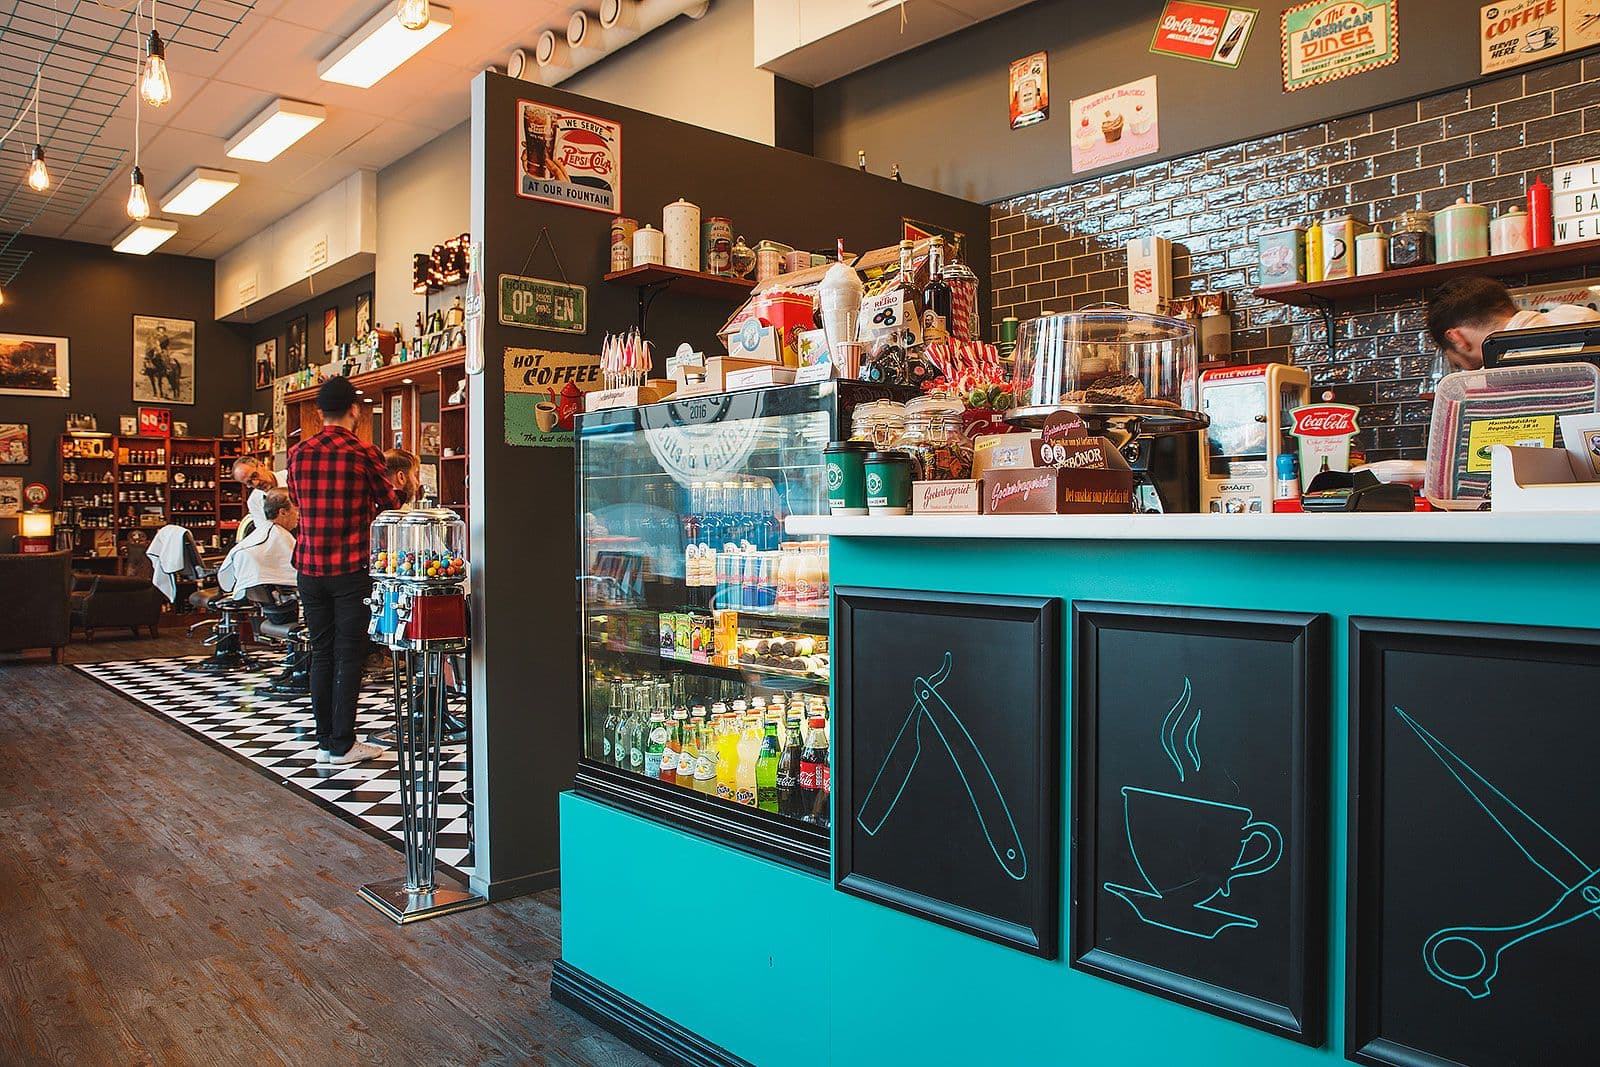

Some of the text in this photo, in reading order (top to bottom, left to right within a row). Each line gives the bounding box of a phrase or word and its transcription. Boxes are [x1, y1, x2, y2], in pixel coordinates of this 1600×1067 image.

[1324, 5, 1346, 24] The
[1486, 0, 1558, 40] COFFEE
[1301, 11, 1374, 43] AMERICAN
[1300, 25, 1374, 58] DINER
[1489, 38, 1520, 52] SERVED
[1491, 45, 1517, 59] HERE
[1117, 89, 1146, 97] BAKED
[565, 119, 603, 135] WE SERVE
[528, 181, 610, 206] AT OUR FOUNTAIN
[512, 290, 533, 315] OP
[1530, 290, 1590, 306] Homestyle
[554, 295, 575, 321] EN
[513, 354, 545, 369] HOT
[523, 364, 601, 386] COFFEE
[689, 404, 708, 420] 2016
[1299, 413, 1351, 431] Coca-Cola
[540, 434, 555, 442] best
